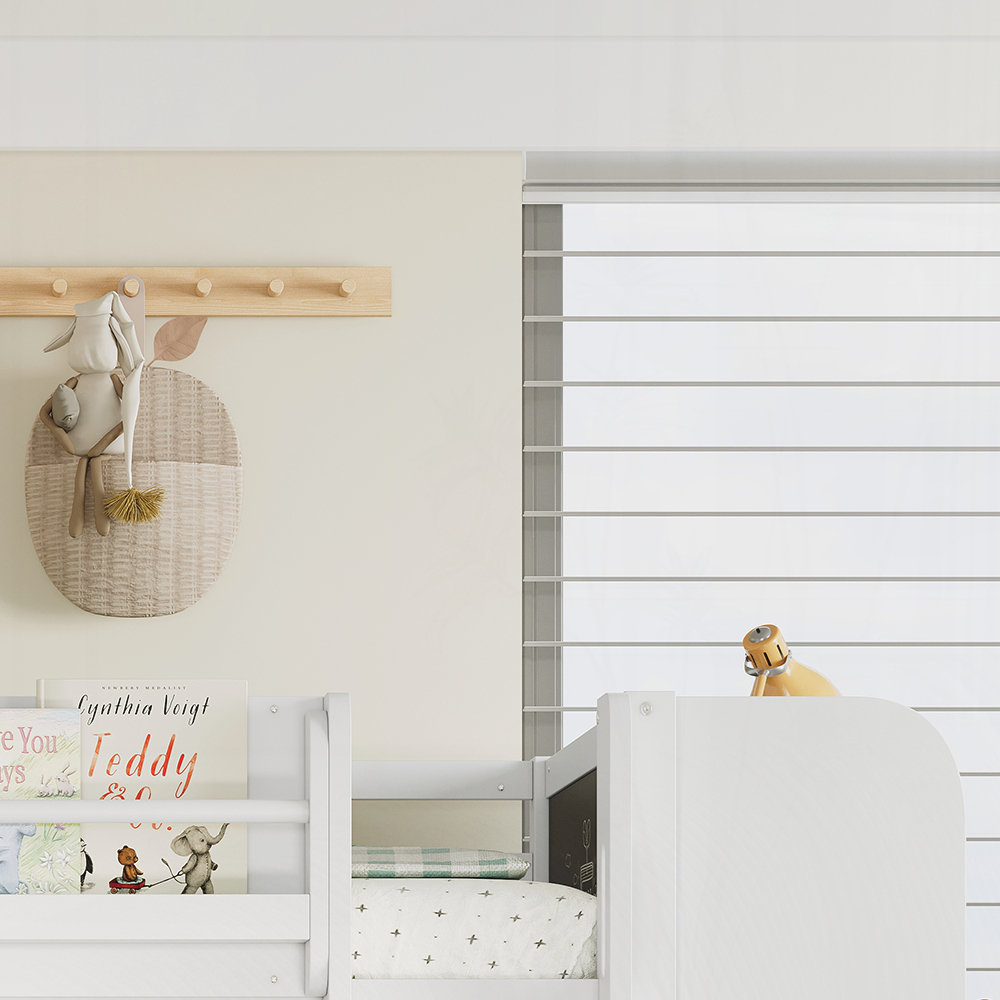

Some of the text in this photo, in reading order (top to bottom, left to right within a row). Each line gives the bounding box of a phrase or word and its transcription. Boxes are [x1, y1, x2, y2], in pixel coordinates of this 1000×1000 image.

[77, 694, 210, 727] Cynthia Voigt
[17, 726, 58, 754] You
[88, 732, 198, 799] Teddy
